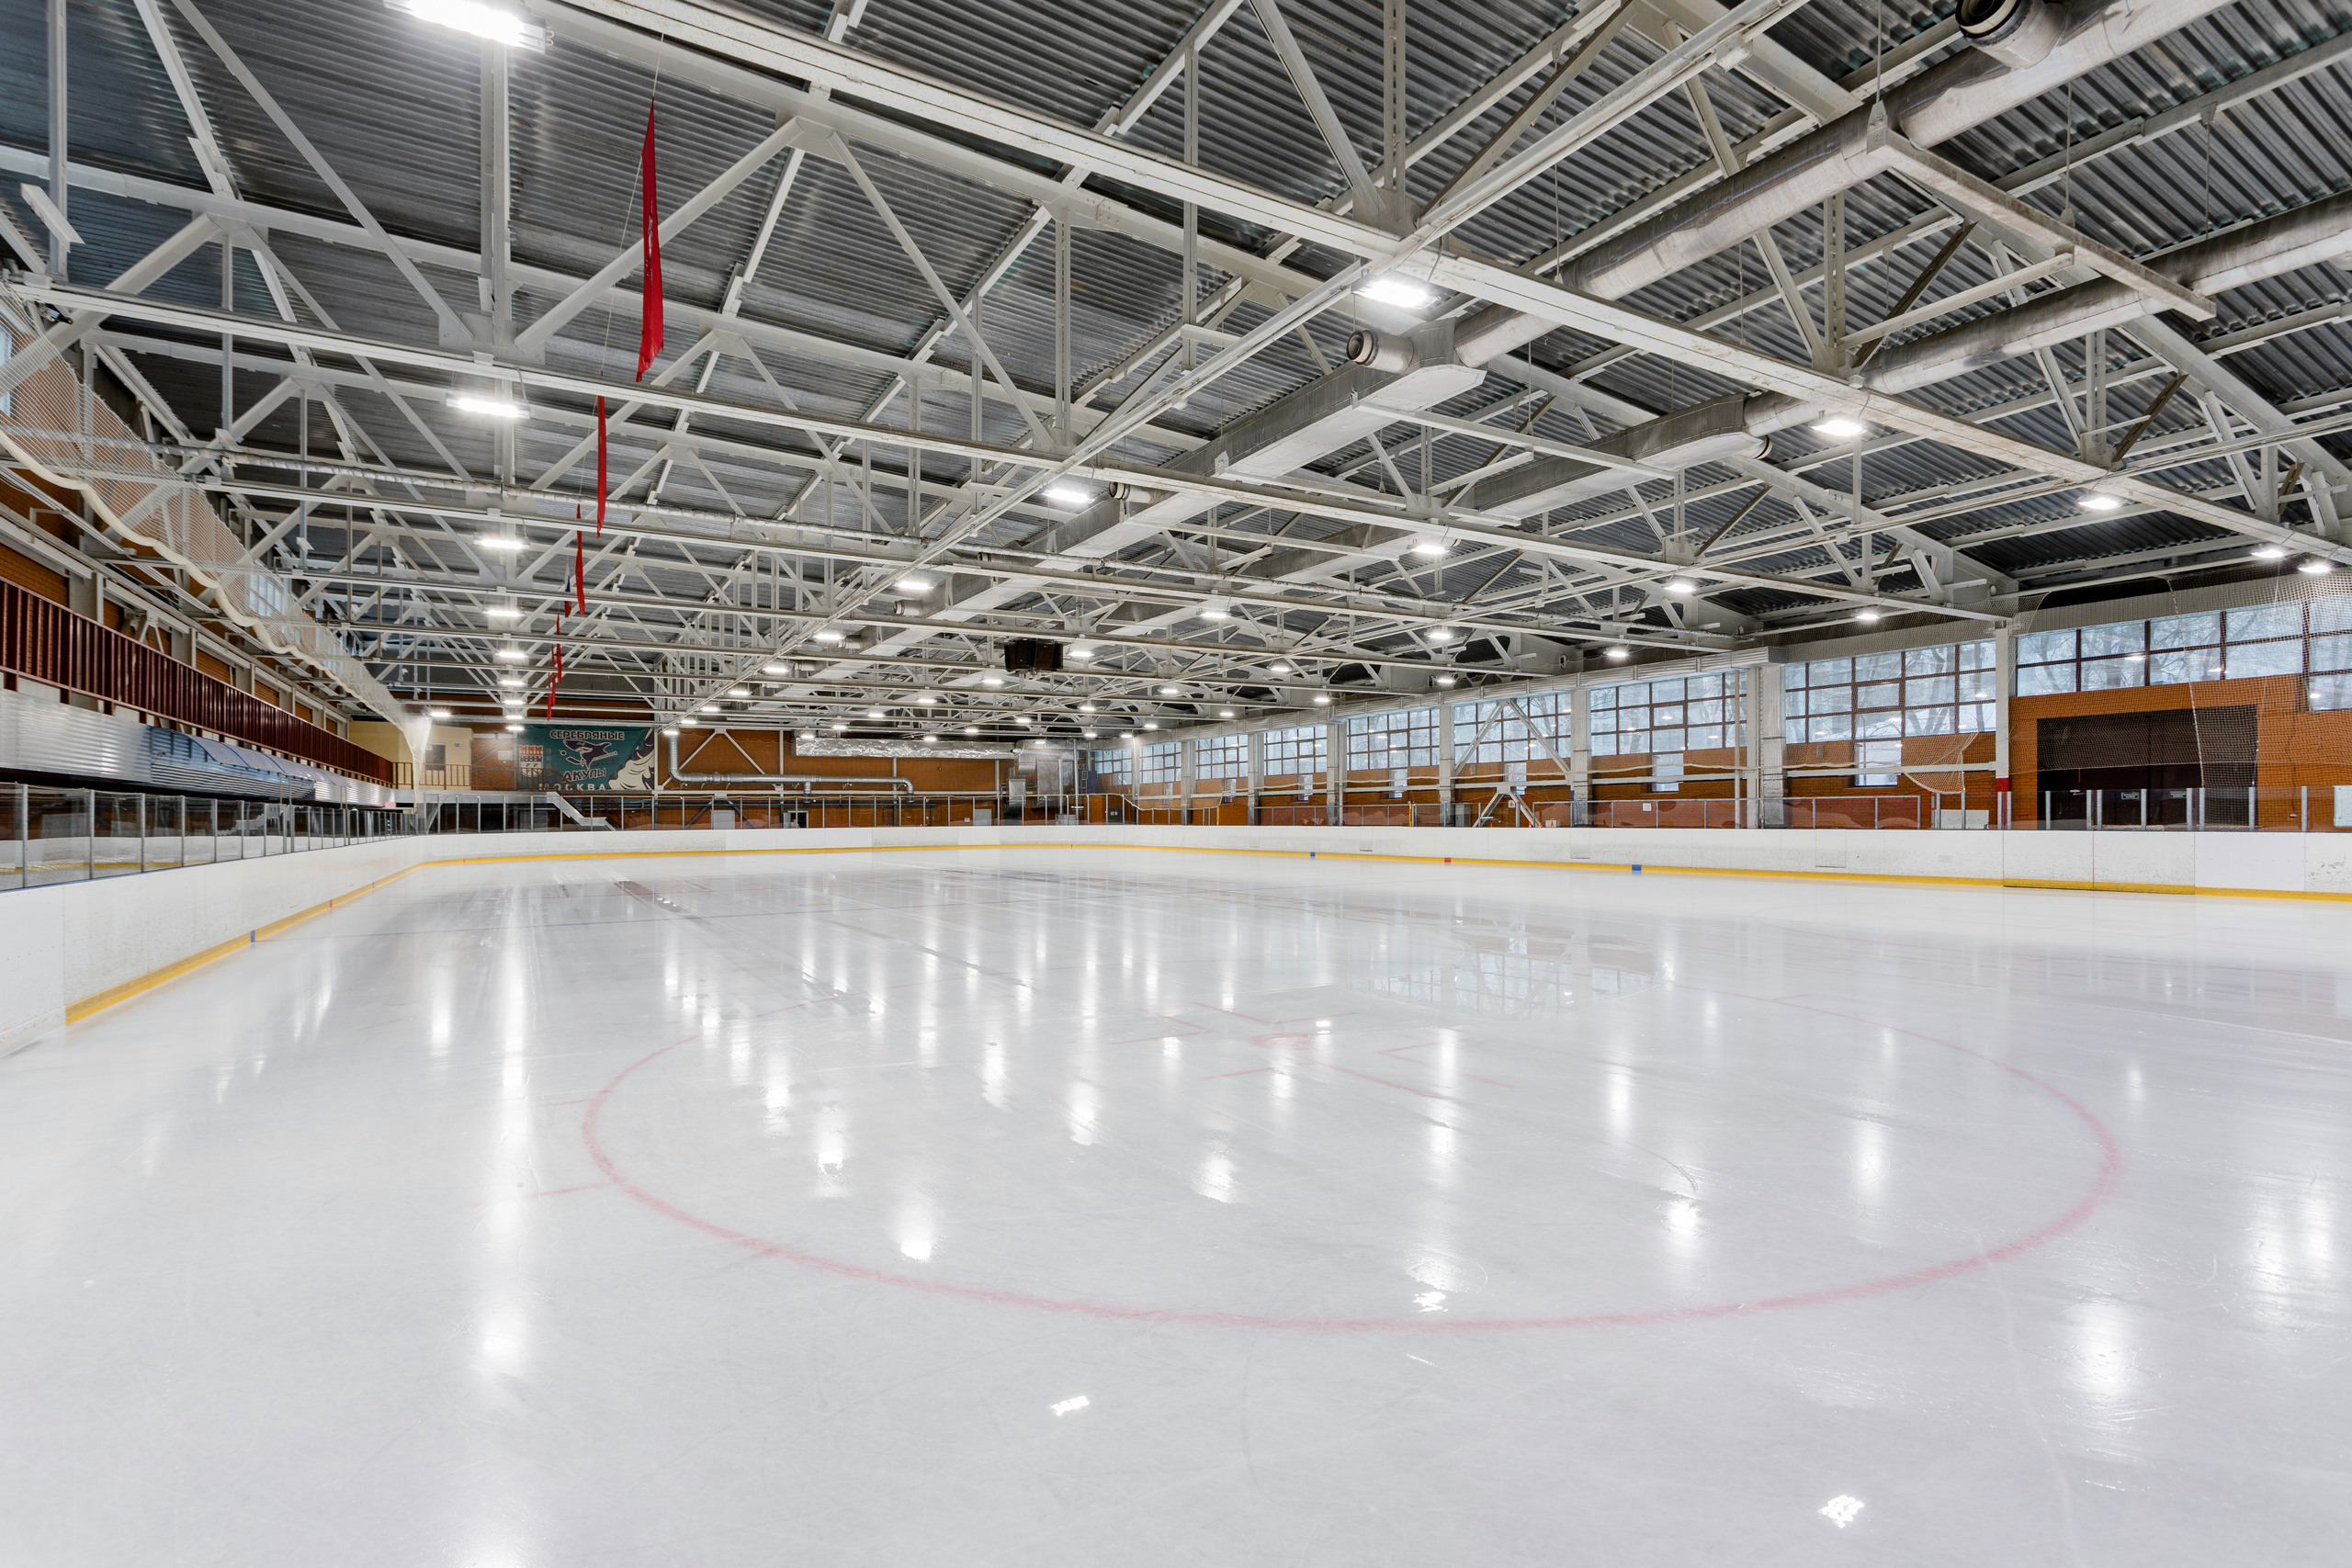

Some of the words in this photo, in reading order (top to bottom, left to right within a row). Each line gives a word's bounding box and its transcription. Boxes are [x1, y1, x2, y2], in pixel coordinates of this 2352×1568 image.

[550, 730, 625, 740] СЕРЕБРЯНЫЕ
[562, 768, 606, 783] АКУЛЫ
[539, 783, 606, 791] МОСКВА
